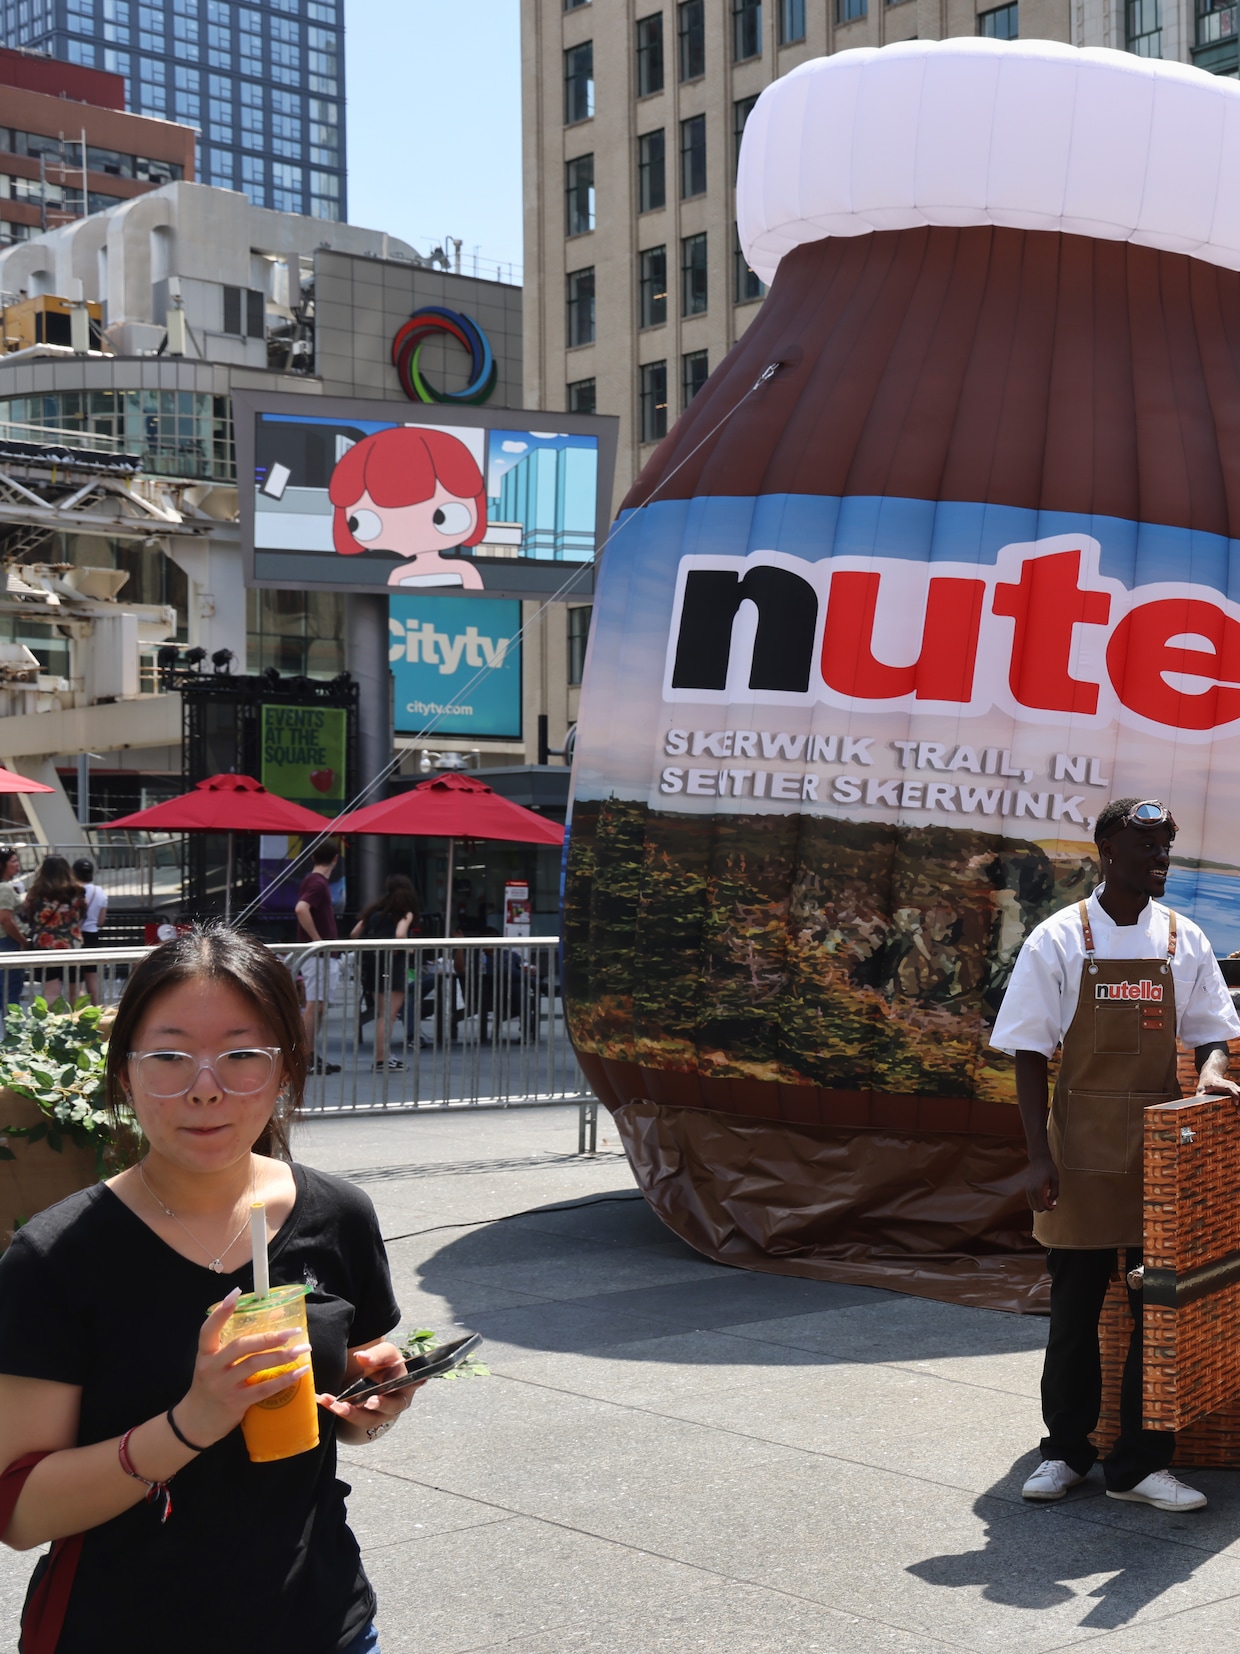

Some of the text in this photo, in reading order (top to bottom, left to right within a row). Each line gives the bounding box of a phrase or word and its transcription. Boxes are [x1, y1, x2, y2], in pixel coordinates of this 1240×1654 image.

[265, 708, 325, 728] EVENTS
[406, 700, 473, 716] citytv.com
[265, 727, 319, 747] AT THE
[265, 745, 327, 767] SQUARE
[892, 740, 1034, 784] TRAIL,
[1054, 752, 1109, 786] NL
[1096, 981, 1163, 1001] nutella
